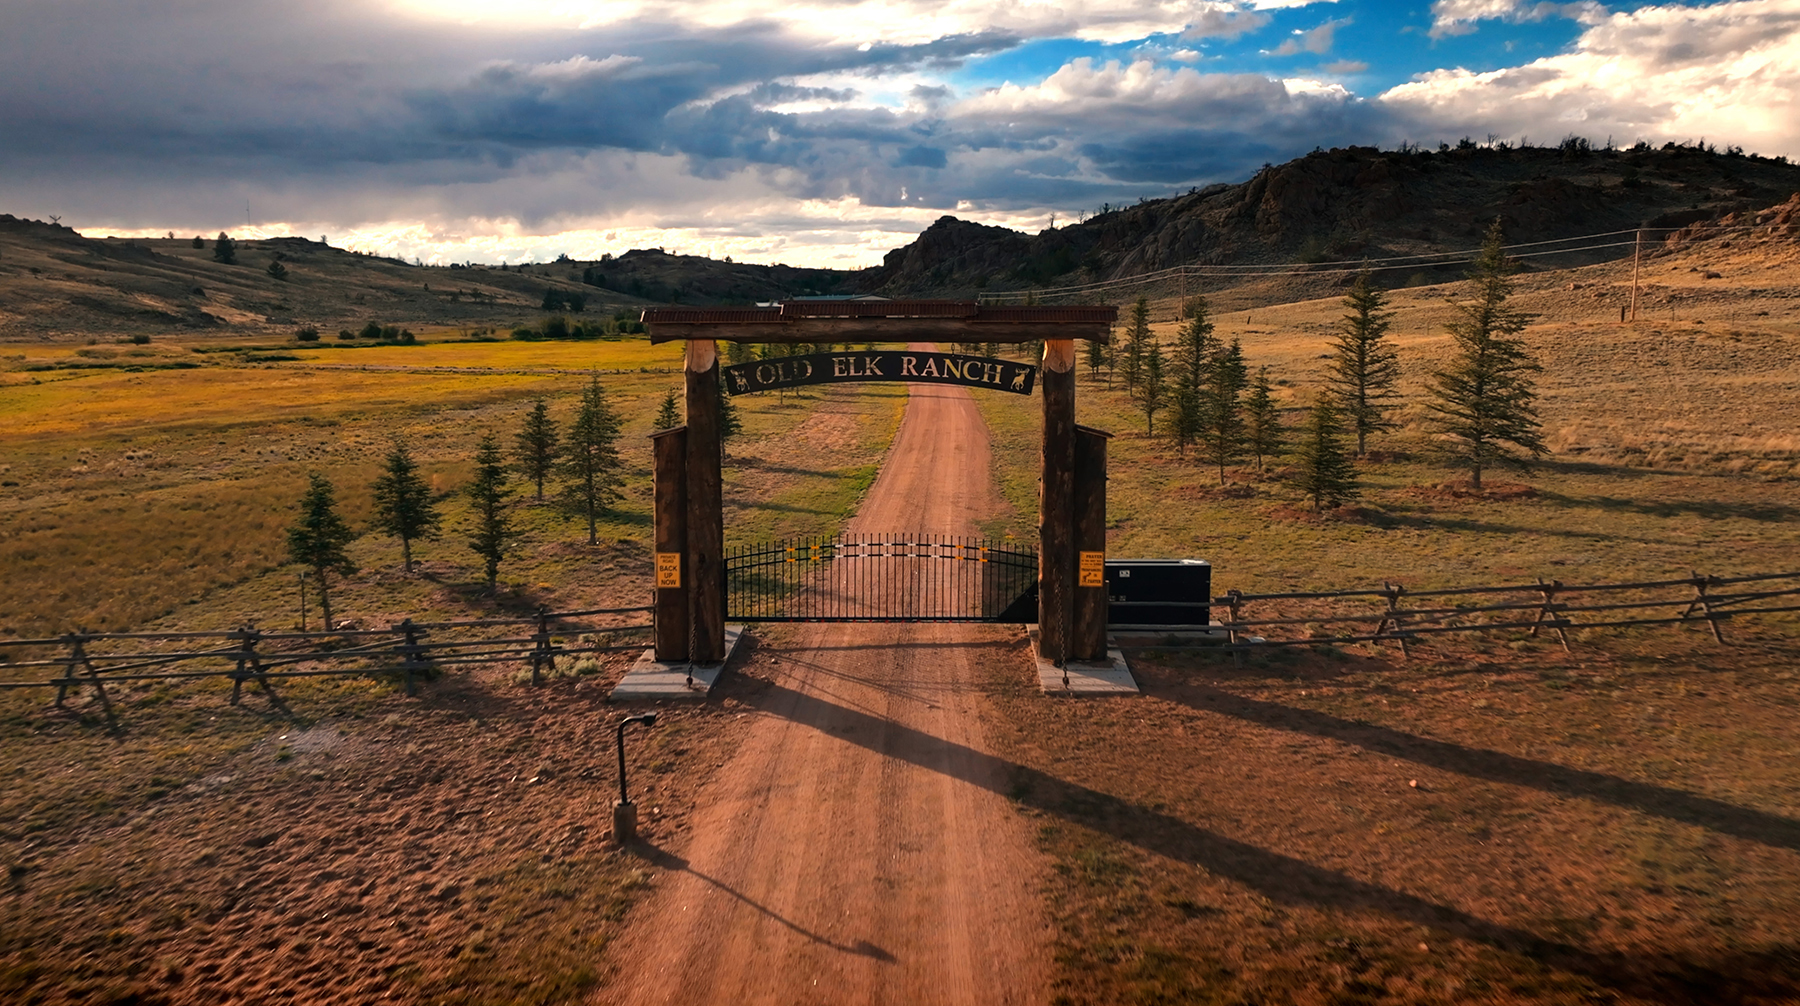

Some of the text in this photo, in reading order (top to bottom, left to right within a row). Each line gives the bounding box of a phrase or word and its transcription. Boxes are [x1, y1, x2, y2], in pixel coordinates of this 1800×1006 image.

[756, 356, 1004, 385] OLD ELK RANCH
